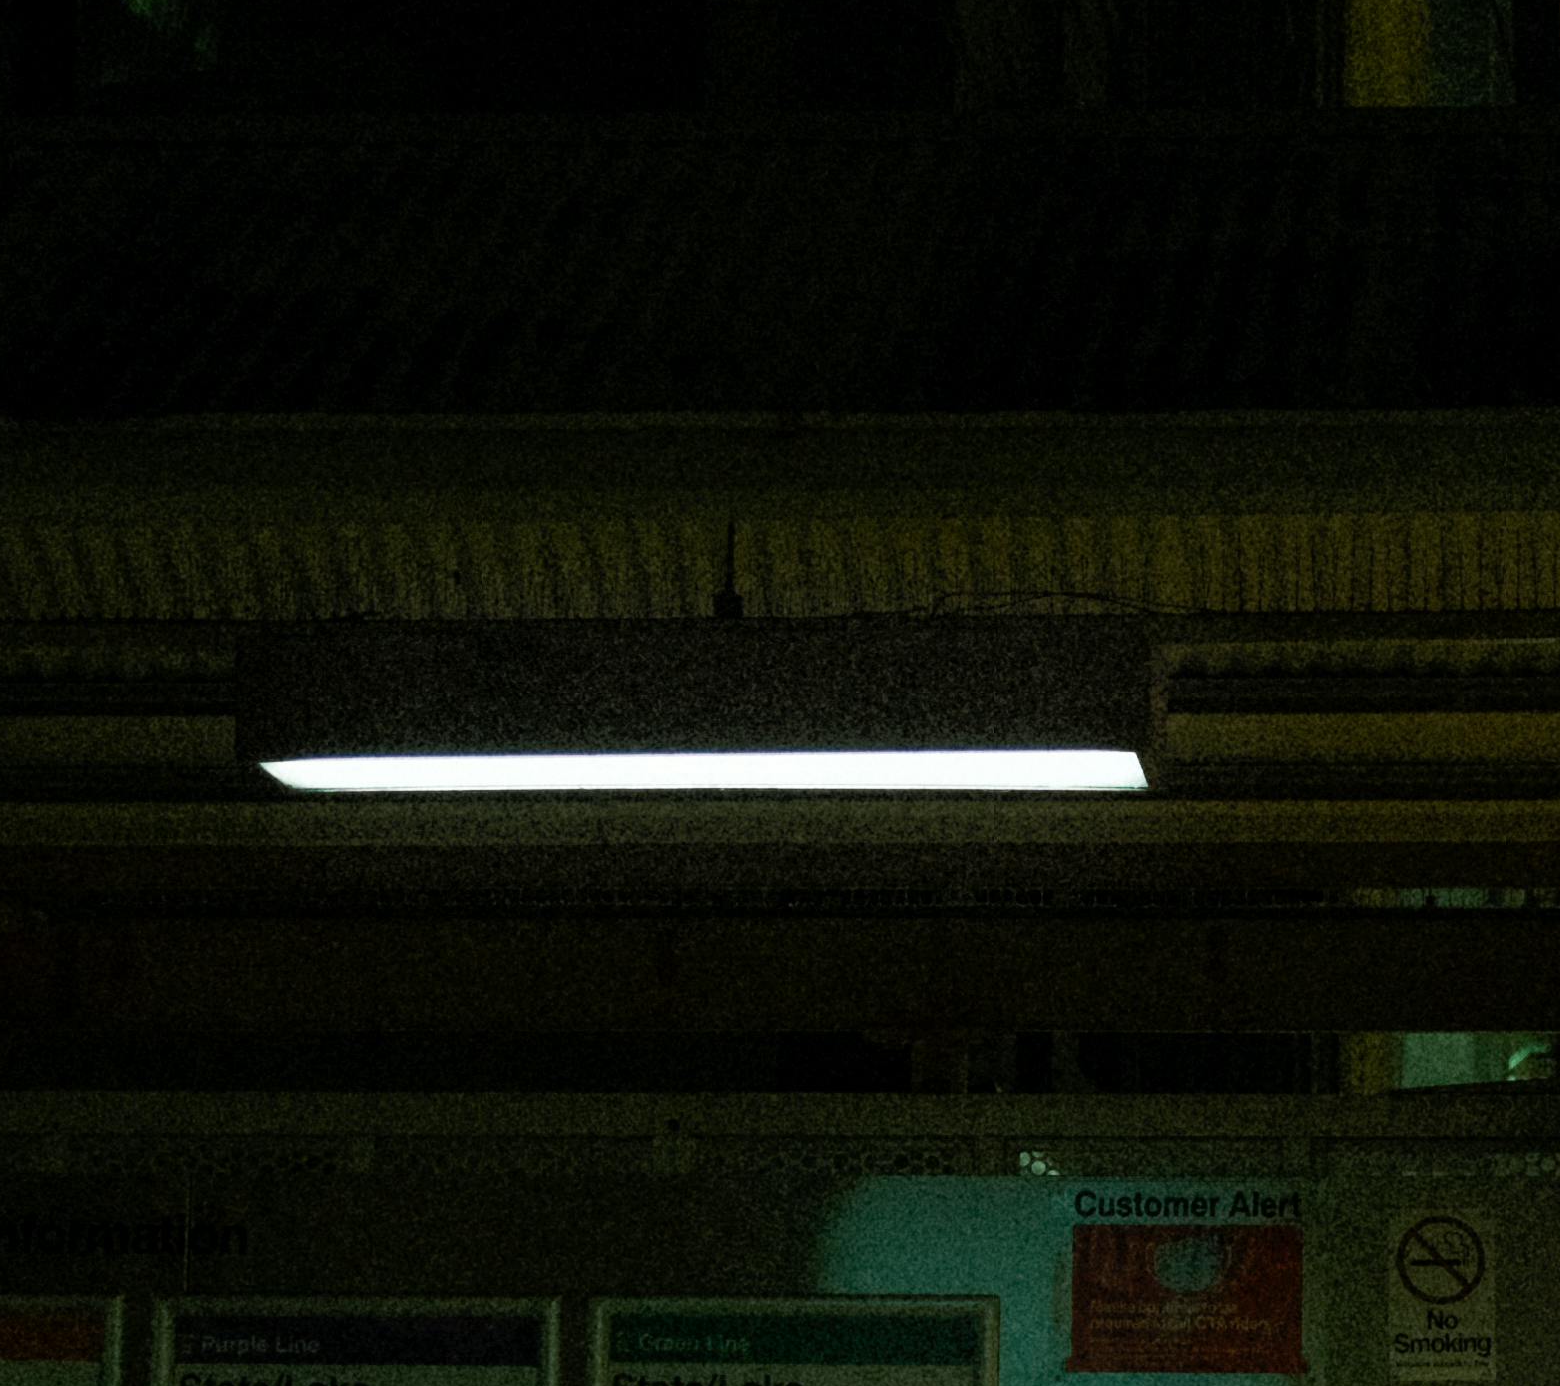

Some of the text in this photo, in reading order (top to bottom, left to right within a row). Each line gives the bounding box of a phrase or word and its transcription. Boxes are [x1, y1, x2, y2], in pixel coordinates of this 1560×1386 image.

[1074, 1189, 1301, 1218] Customer Alert
[1426, 1309, 1459, 1330] No
[200, 1334, 321, 1356] Purple Line
[1393, 1332, 1492, 1358] Smoking
